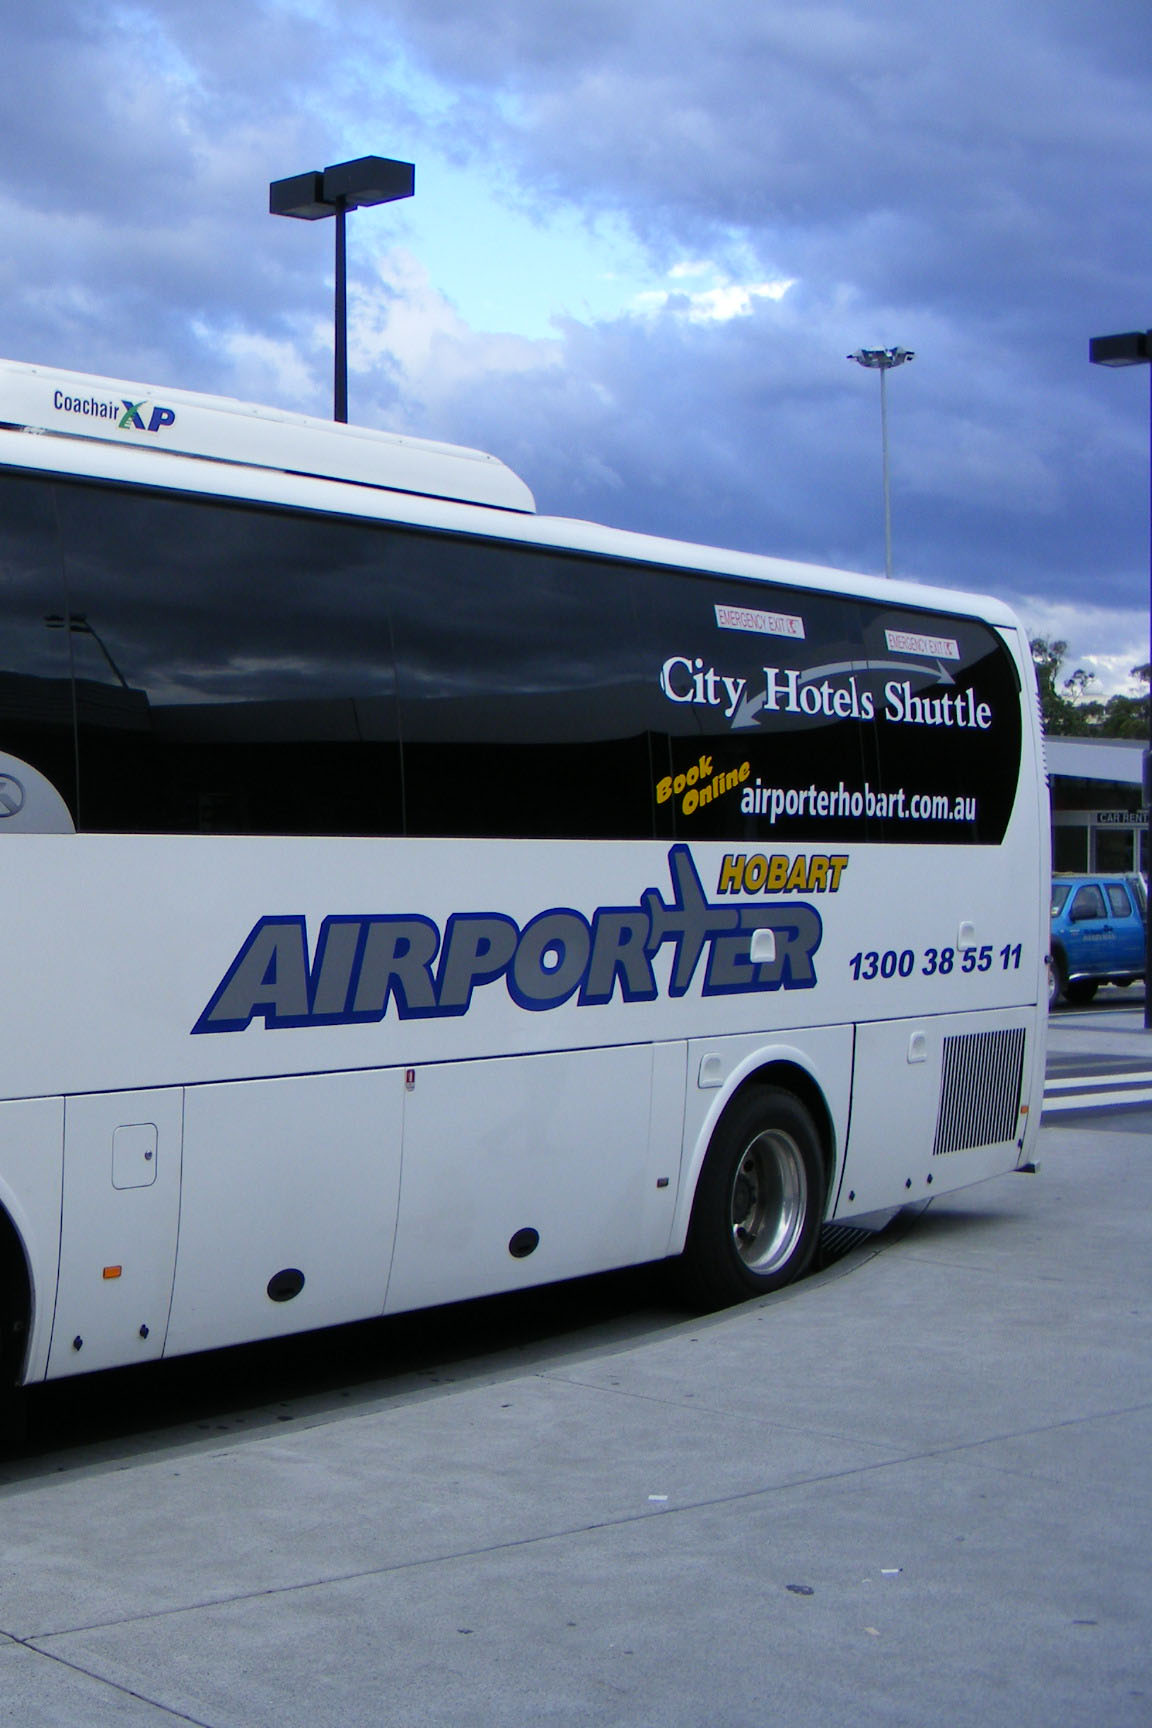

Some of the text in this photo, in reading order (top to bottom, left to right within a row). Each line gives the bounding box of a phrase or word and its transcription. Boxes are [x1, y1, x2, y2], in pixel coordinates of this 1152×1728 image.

[53, 390, 176, 433] Coachair XP
[718, 609, 786, 633] EMERGENCY EXIT
[661, 656, 992, 729] City Hotels Shuttle
[656, 755, 713, 804] Book
[681, 761, 751, 816] Online
[740, 778, 977, 823] airporterhobart.com.au
[1100, 812, 1120, 823] CAR
[717, 854, 849, 895] HOBART
[191, 843, 824, 1034] AIRPORTER
[849, 943, 1022, 981] 1300 38 55 11
